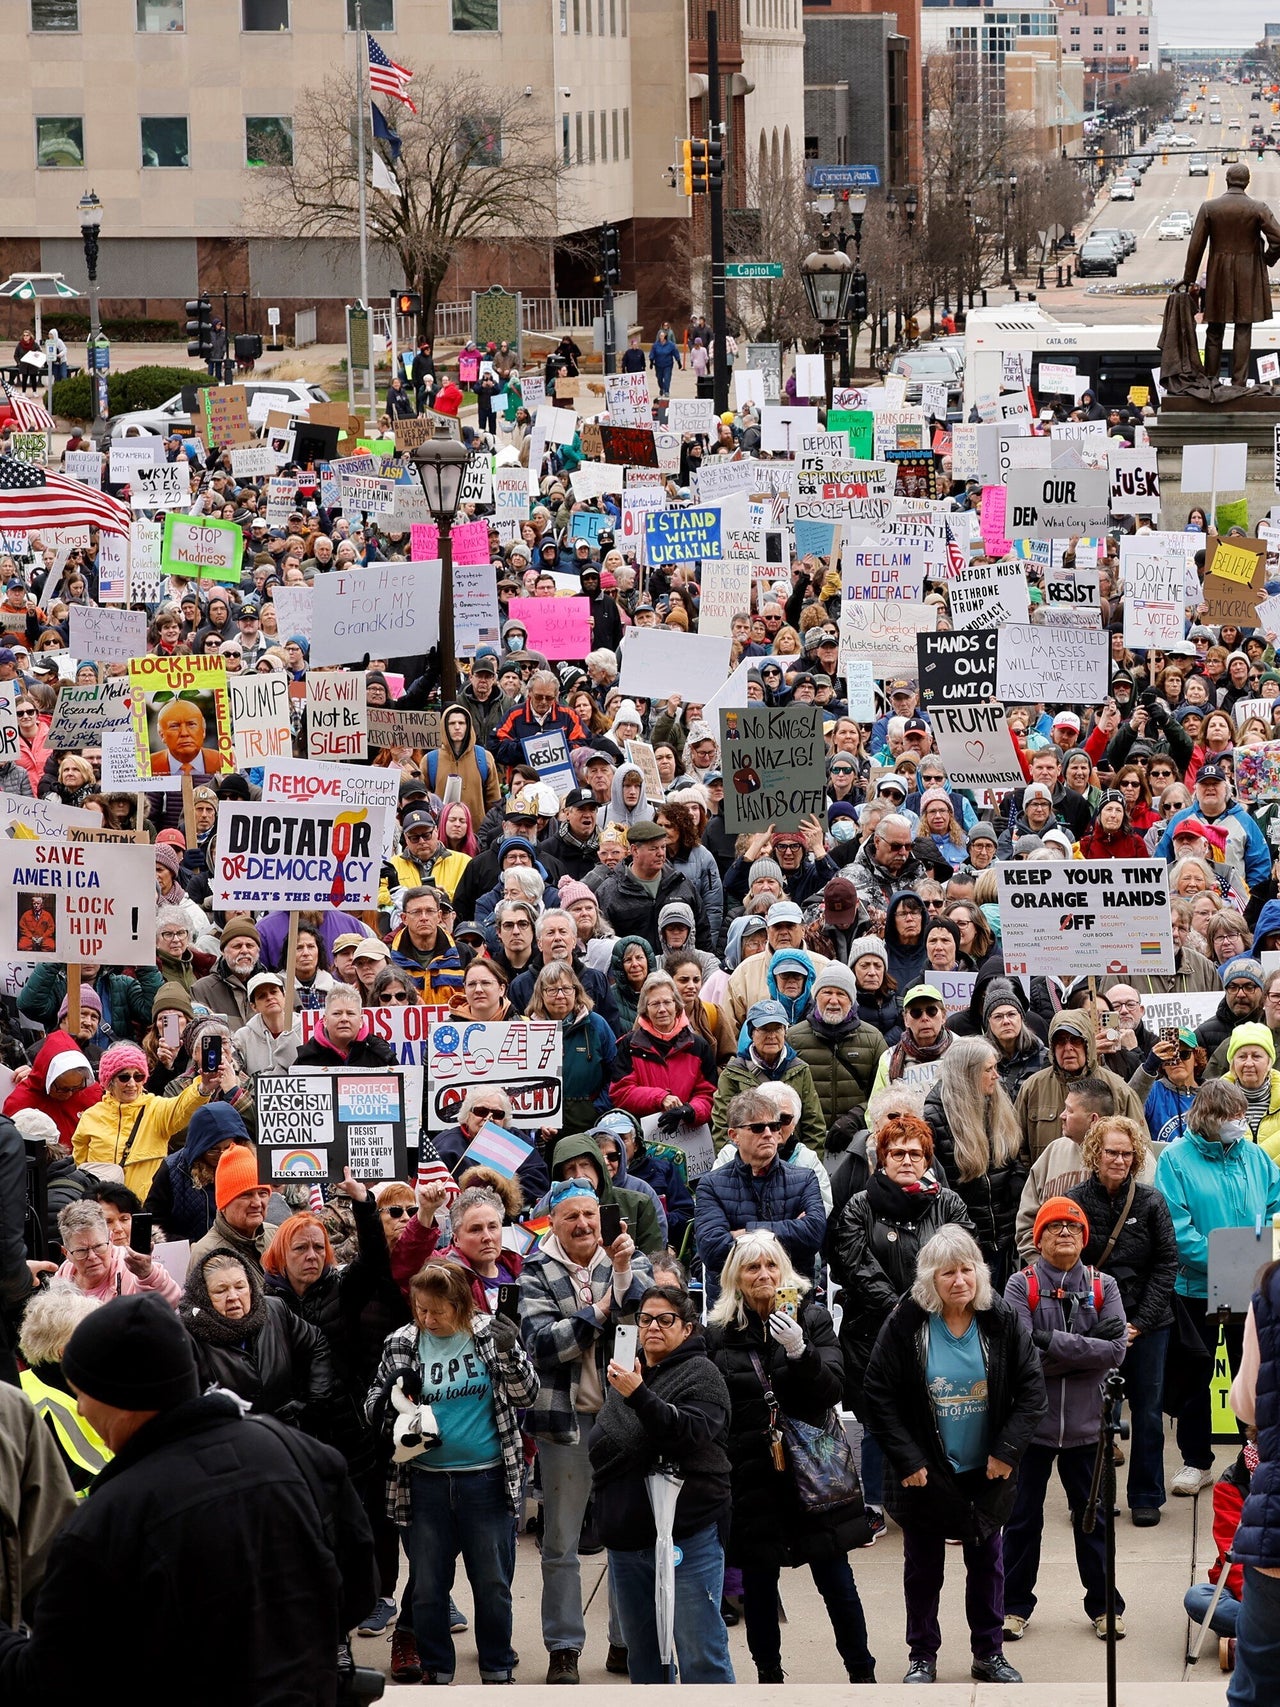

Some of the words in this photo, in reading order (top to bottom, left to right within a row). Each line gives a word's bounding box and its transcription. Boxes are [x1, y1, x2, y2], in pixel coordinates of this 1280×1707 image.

[854, 169, 871, 180] Bank
[738, 264, 769, 277] Capitol
[1045, 337, 1078, 345] CATA.ORG
[355, 478, 380, 488] STOP
[797, 468, 886, 485] SPRINGTIME
[342, 487, 393, 502] DISAPPEARING
[823, 483, 868, 498] ELON
[872, 483, 885, 494] IN
[1043, 480, 1077, 504] OUR
[349, 498, 385, 512] PEOPLE
[648, 513, 654, 529] I
[658, 511, 716, 531] STAND
[187, 526, 222, 539] STOP
[665, 528, 707, 544] WITH
[651, 540, 720, 562] UKRAINE
[856, 552, 911, 566] RECLAIM
[871, 569, 898, 582] OUR
[391, 591, 414, 607] MY
[847, 585, 919, 600] DEMOCRACY
[1010, 627, 1041, 644] OUR
[1051, 629, 1106, 645] HUDDLED
[1032, 646, 1085, 657] MASSES
[131, 657, 180, 674] LOCK
[186, 656, 223, 671] HIM
[1005, 658, 1040, 670] WILL
[1051, 660, 1100, 672] DEFEAT
[167, 672, 195, 688] UP
[1037, 672, 1064, 681] YOUR
[1000, 682, 1048, 698] FASCIST
[1057, 683, 1097, 699] ASSES
[233, 680, 286, 719] DUMP
[742, 716, 765, 739] NO
[768, 709, 817, 738] KINGS!
[929, 707, 1003, 733] TRUMP
[236, 726, 289, 757] TRUMP
[732, 748, 751, 769] NO
[755, 742, 813, 768] NAZIS!
[269, 773, 340, 796] REMOVE
[949, 772, 1022, 784] COMMUNISM
[340, 788, 397, 805] Politicians
[736, 790, 788, 822] HANDS
[790, 785, 827, 819] OFF!
[229, 807, 370, 855] DICTATOR
[35, 846, 84, 865] SAVE
[12, 867, 100, 888] AMERICA
[247, 858, 373, 882] DEMOCRACY
[1005, 868, 1053, 885] KEEP
[1063, 868, 1114, 884] YOUR
[1122, 867, 1163, 883] TINY
[285, 891, 310, 902] THE
[1010, 891, 1089, 908] ORANGE
[1103, 890, 1166, 906] HANDS
[65, 895, 114, 917] LOCK
[70, 917, 107, 935] HIM
[1059, 913, 1095, 931] OFF
[79, 936, 102, 956] UP
[259, 1077, 307, 1093] MAKE
[341, 1083, 397, 1095] PROTECT
[259, 1095, 331, 1109] FASCISM
[348, 1093, 390, 1105] TRANS
[348, 1102, 392, 1115] YOUTH.
[260, 1111, 324, 1126] WRONG
[260, 1127, 317, 1143] AGAIN.
[354, 1126, 377, 1135] RESIST
[350, 1137, 365, 1145] THIS
[368, 1137, 384, 1145] SHIT
[350, 1147, 368, 1156] WITH
[371, 1147, 393, 1156] EVERY
[350, 1158, 369, 1167] FIBER
[372, 1157, 379, 1166] OF
[350, 1168, 360, 1177] MY
[363, 1168, 383, 1177] BEING
[446, 1380, 489, 1400] today
